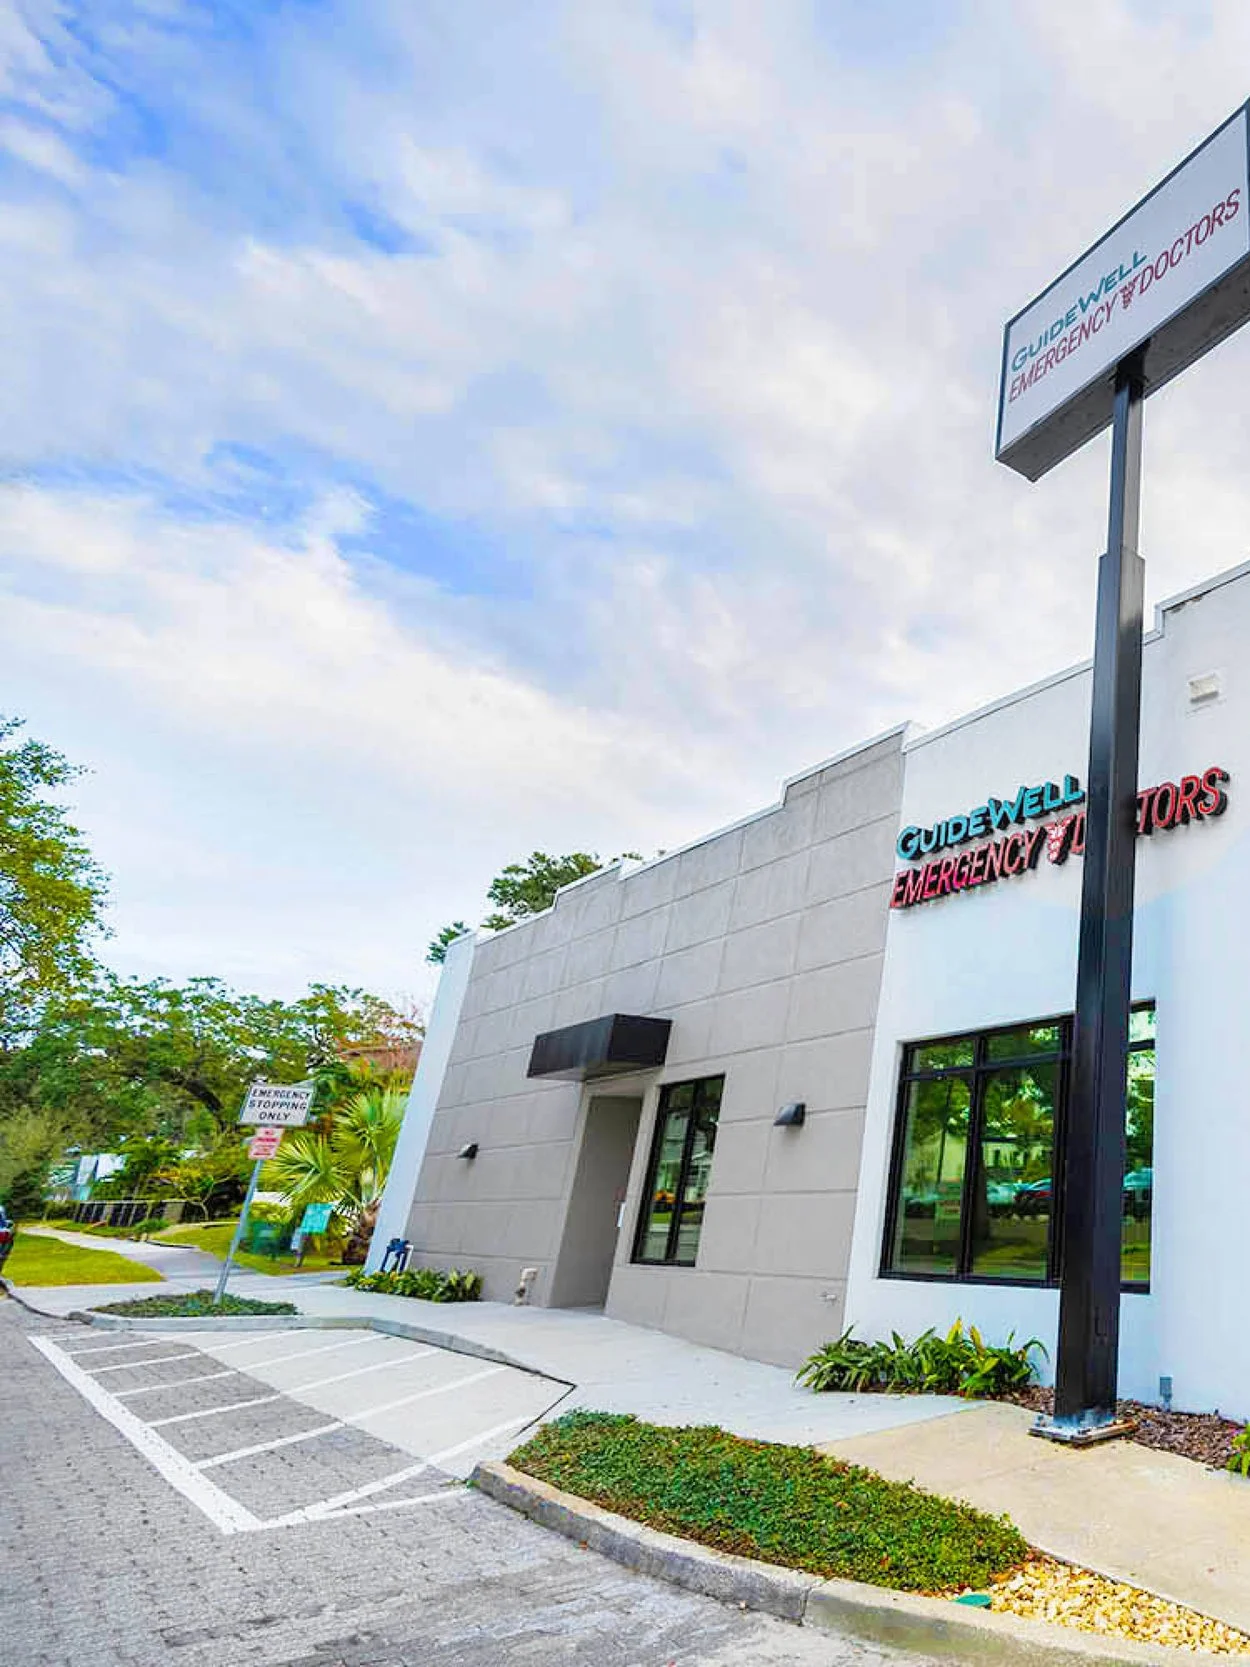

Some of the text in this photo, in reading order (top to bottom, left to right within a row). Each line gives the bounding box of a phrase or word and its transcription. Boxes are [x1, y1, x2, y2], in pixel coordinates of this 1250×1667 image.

[1009, 188, 1240, 402] EMERGENCY DOCTORS
[889, 825, 1045, 909] EMERGENCY
[252, 1089, 309, 1099] EMERGENCY
[248, 1100, 307, 1110] STOPPING
[259, 1111, 290, 1120] ONLY
